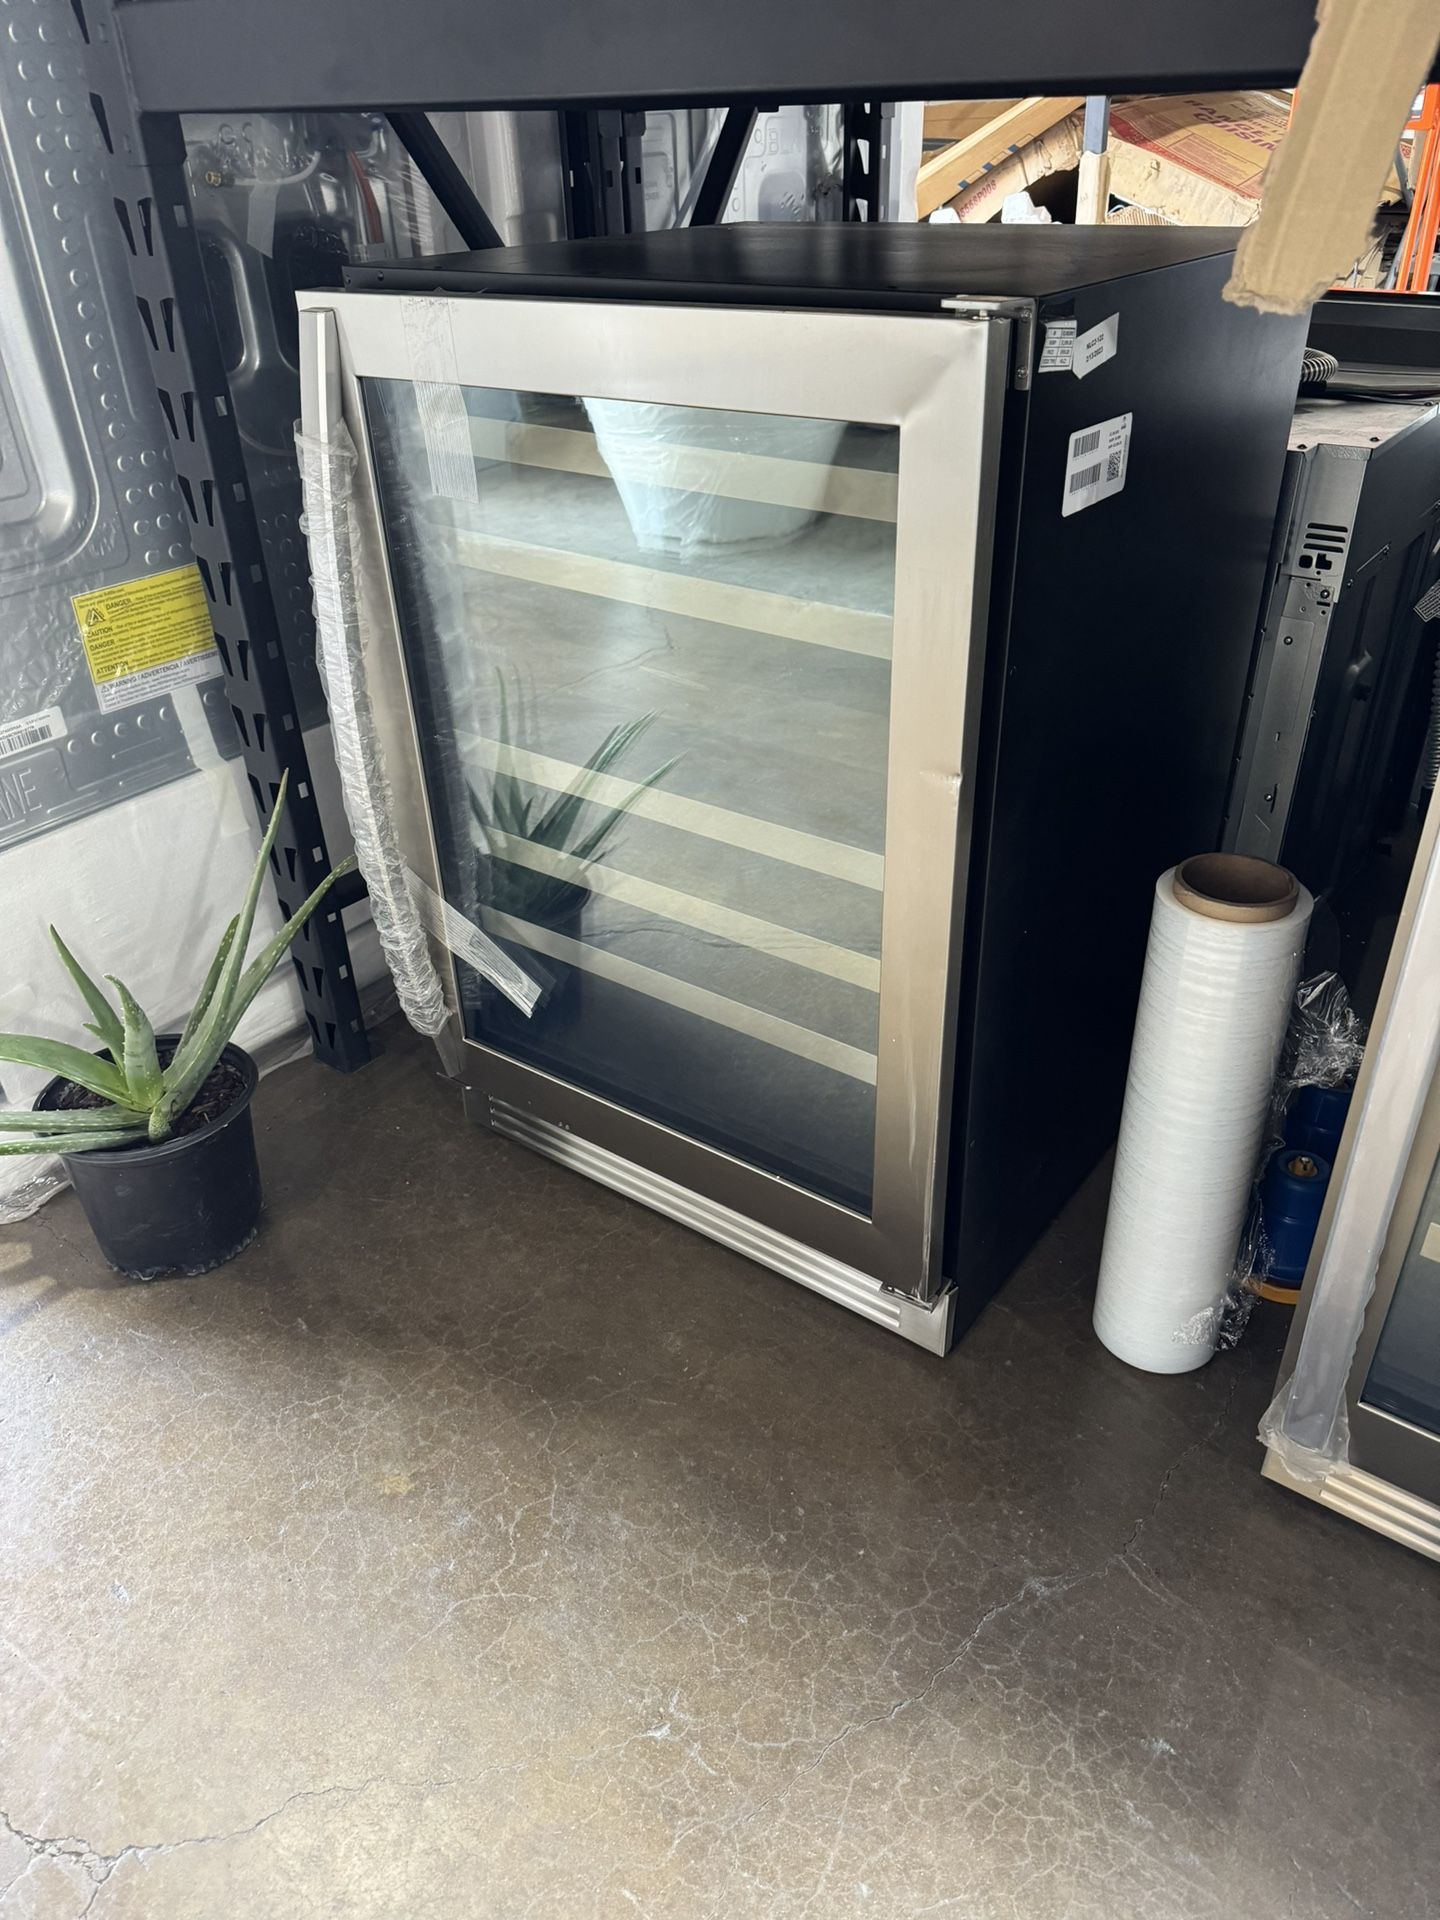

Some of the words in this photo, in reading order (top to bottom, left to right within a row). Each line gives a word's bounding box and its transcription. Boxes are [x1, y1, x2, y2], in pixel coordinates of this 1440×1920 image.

[1193, 113, 1276, 151] CUISIN
[105, 598, 132, 610] DANGER
[86, 626, 113, 638] CAUTION
[89, 639, 115, 652] DANGER
[96, 660, 129, 675] ATTENTION
[140, 663, 179, 679] ADVERTENCIA
